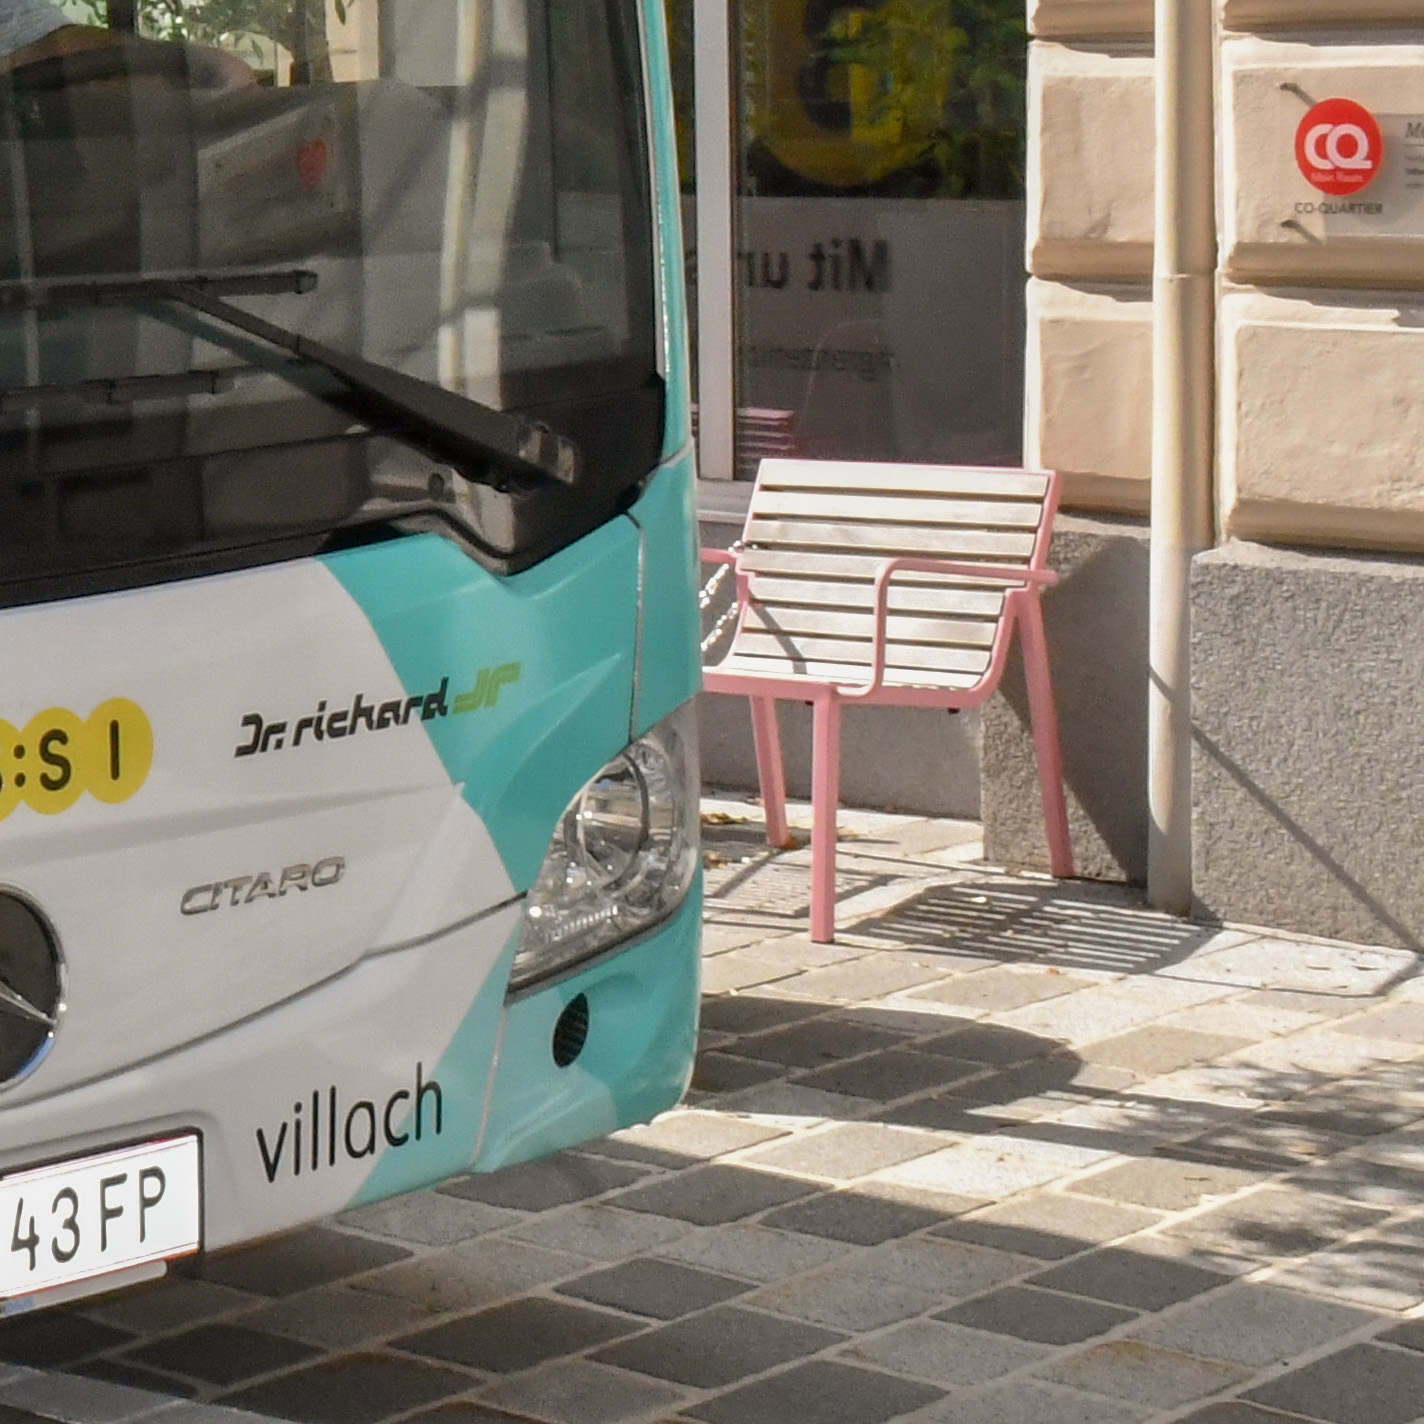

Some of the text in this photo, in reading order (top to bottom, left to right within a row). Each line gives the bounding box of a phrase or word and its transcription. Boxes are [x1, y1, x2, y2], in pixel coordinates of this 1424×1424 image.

[1303, 122, 1373, 170] CQ
[180, 855, 346, 917] CITARO
[255, 1060, 443, 1184] villach
